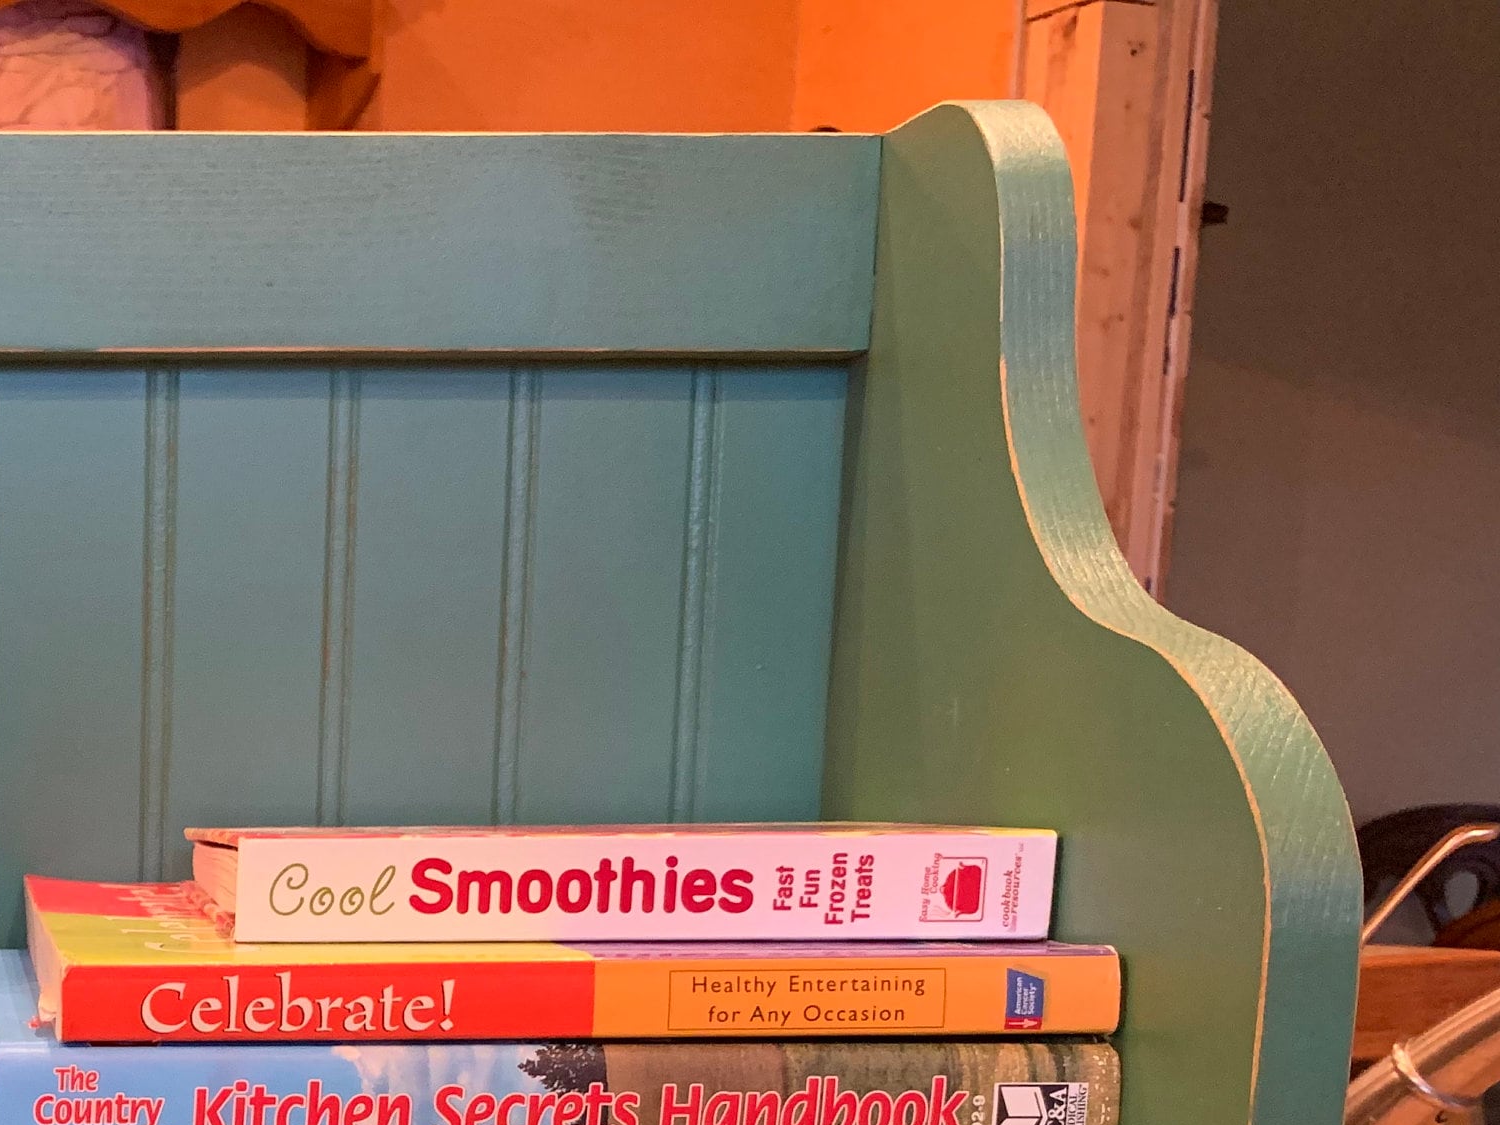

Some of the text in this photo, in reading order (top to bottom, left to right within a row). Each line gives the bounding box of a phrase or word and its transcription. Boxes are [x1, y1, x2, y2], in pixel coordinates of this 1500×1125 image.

[269, 855, 754, 916] Cool Smoothies
[773, 865, 794, 911] Fast
[800, 869, 821, 908] Fun
[825, 852, 848, 925] Frozen
[851, 854, 874, 922] Treats
[919, 867, 931, 922] Easy Home
[930, 852, 943, 894] Cooking
[1010, 854, 1022, 914] resources
[1001, 869, 1013, 927] cookbook
[141, 971, 455, 1033] Celebrate!
[692, 975, 925, 997] Healthy Entertaining
[1014, 977, 1022, 1014] American
[1021, 988, 1029, 1015] Cancer
[708, 1004, 905, 1026] for Any Occasion
[54, 1066, 99, 1092] The
